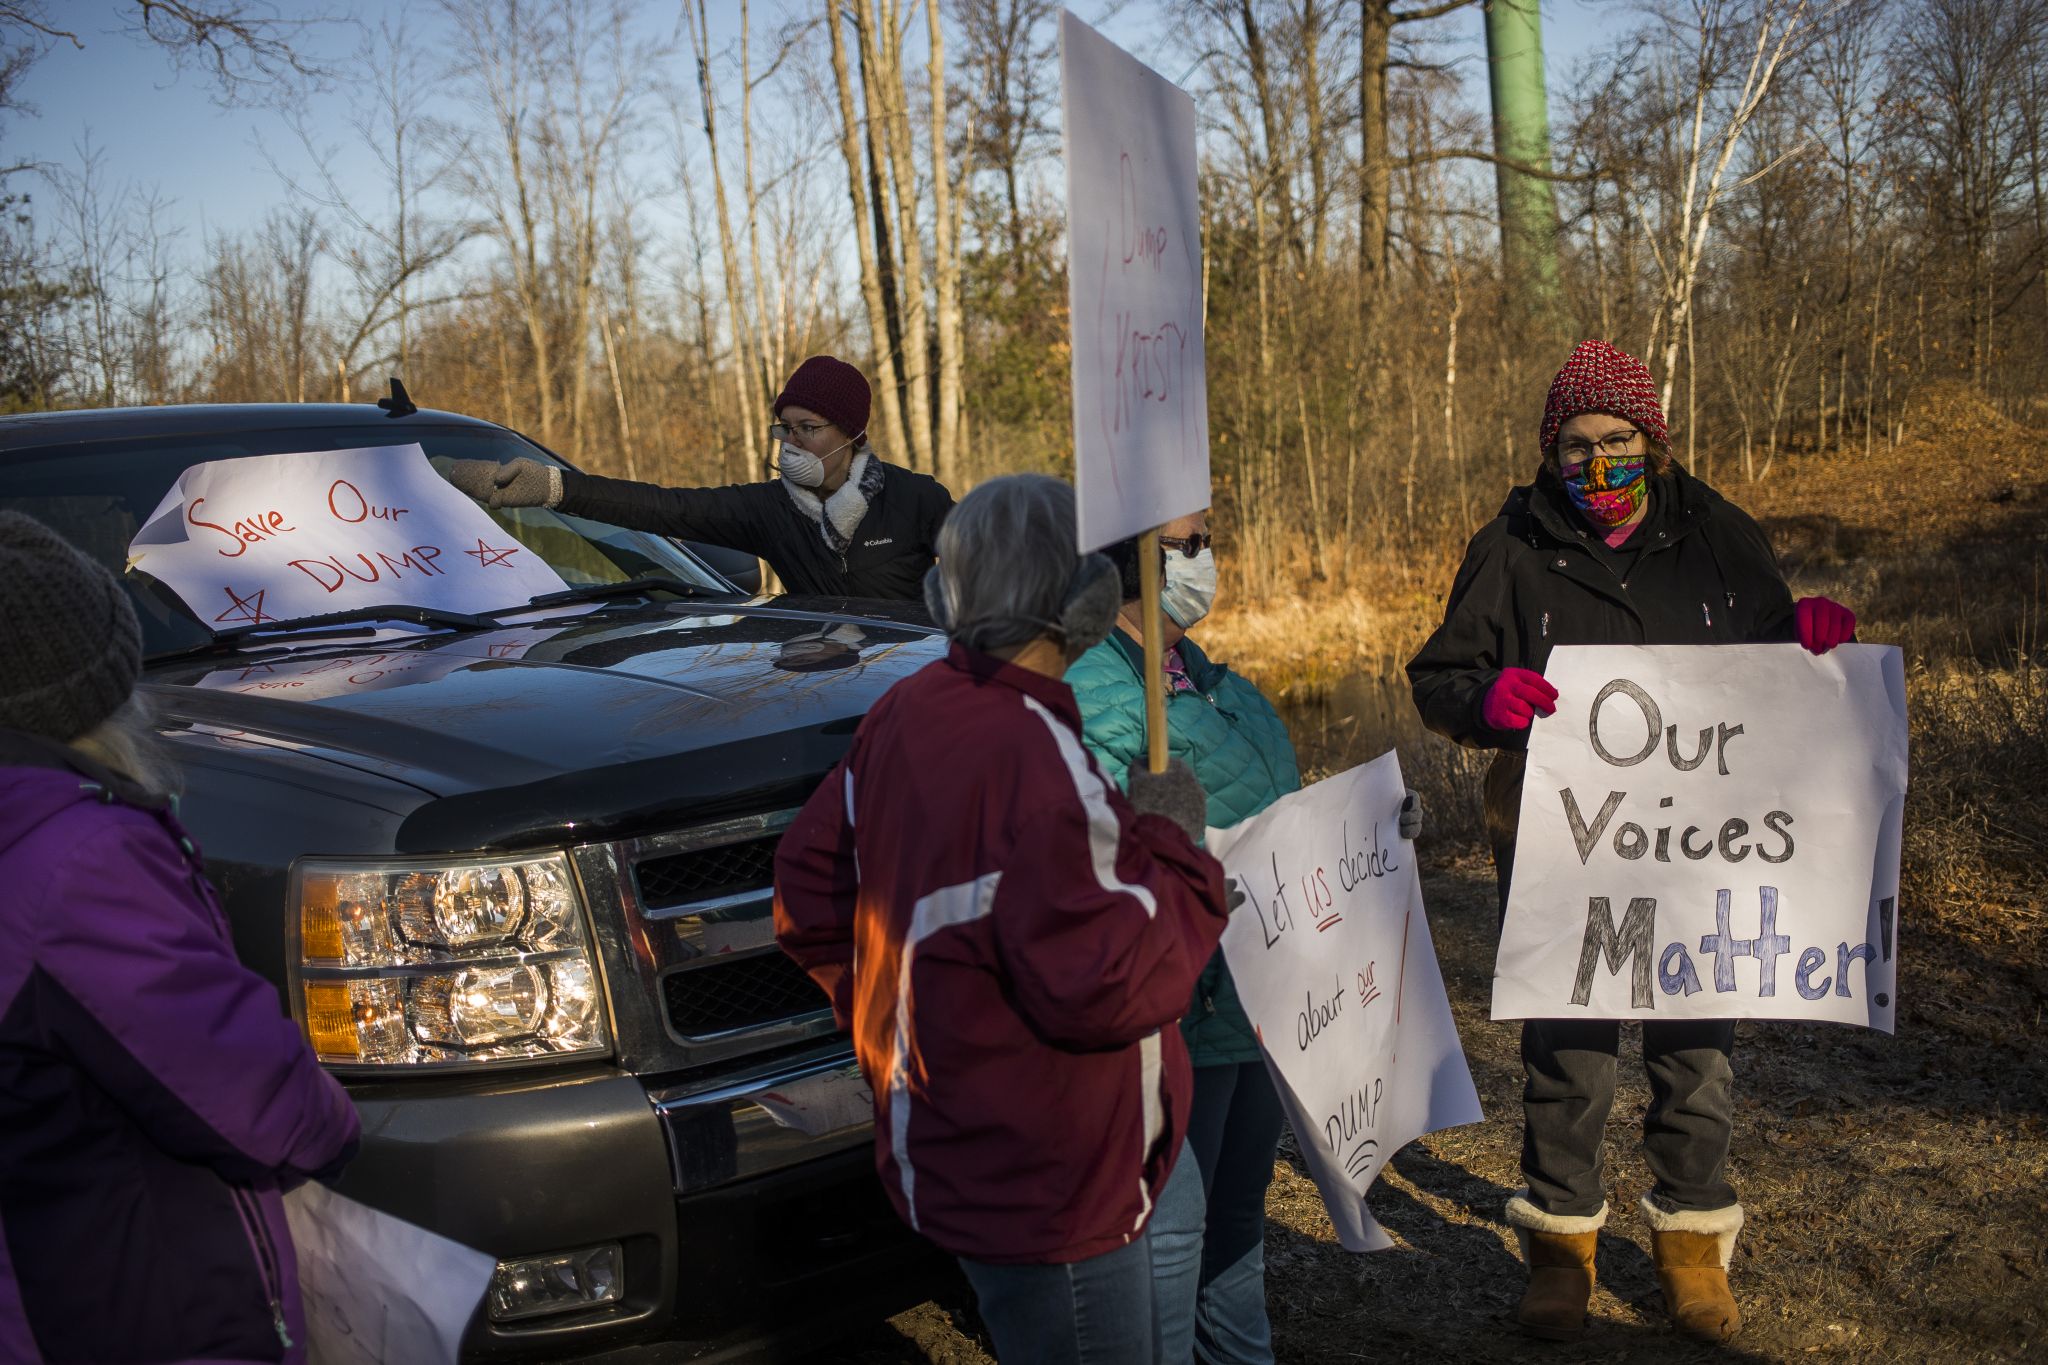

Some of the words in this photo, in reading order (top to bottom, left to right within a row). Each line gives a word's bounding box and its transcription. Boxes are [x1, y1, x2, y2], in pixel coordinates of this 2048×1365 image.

[1120, 148, 1168, 274] Dump
[187, 497, 297, 558] Save
[327, 479, 410, 523] Our
[869, 537, 893, 546] Columbia
[286, 545, 446, 594] DUMP
[1588, 677, 1745, 776] Our
[1558, 786, 1795, 866] Voices
[1239, 850, 1295, 951] Let
[1338, 819, 1400, 893] decide
[1566, 884, 1896, 1011] Matter!
[1296, 973, 1345, 1051] about
[1356, 958, 1377, 997] our
[1324, 1077, 1383, 1158] DUMP
